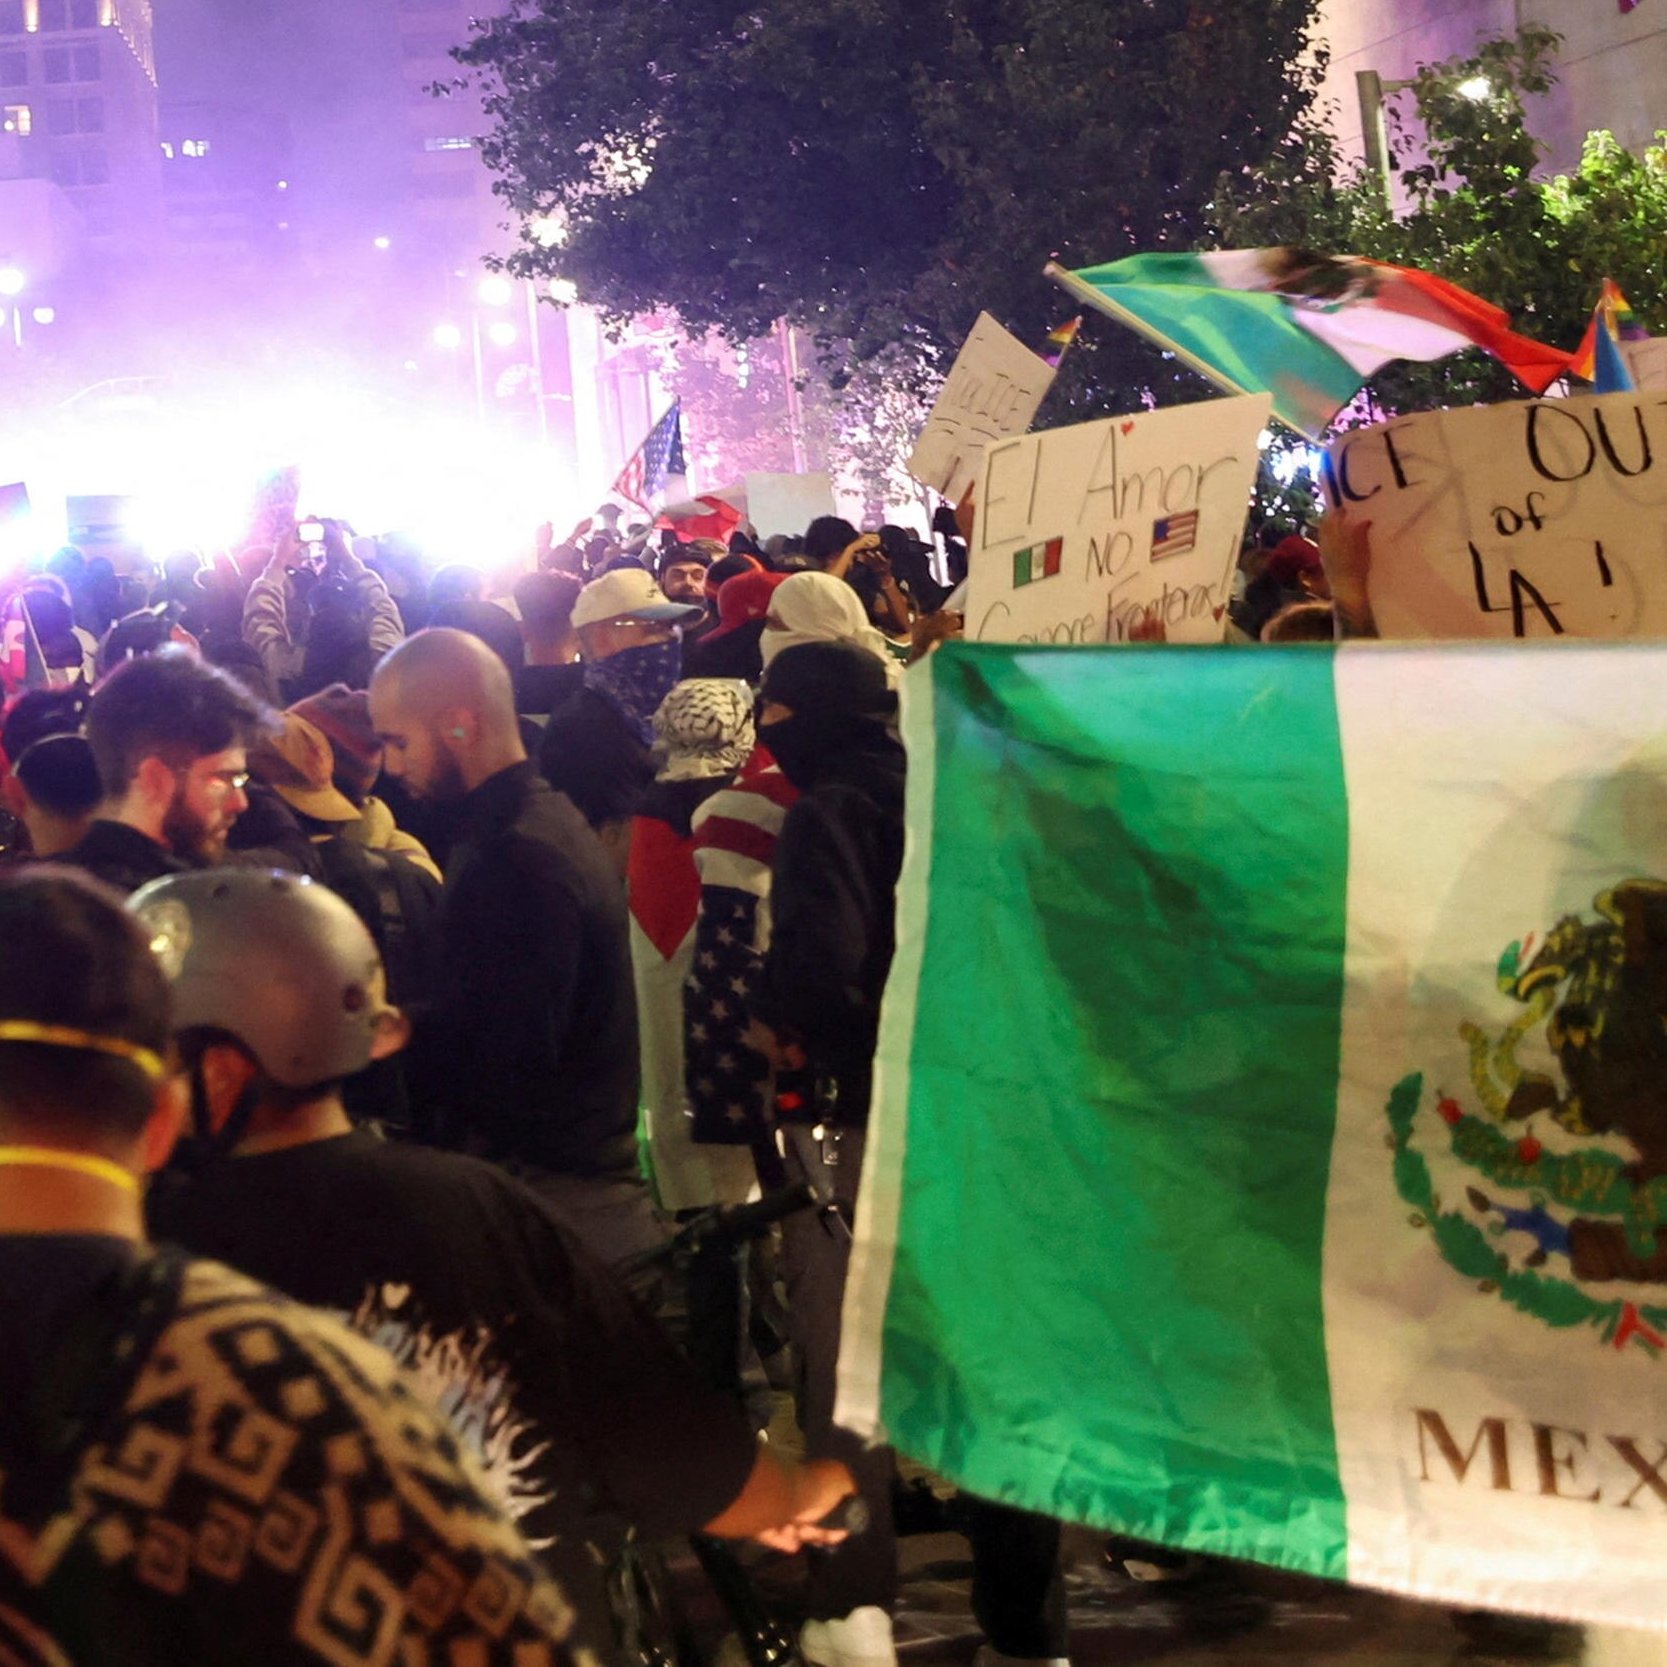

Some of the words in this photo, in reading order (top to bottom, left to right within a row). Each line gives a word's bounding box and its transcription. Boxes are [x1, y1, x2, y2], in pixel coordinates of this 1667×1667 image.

[1525, 401, 1667, 482] OU
[982, 438, 1042, 551] El
[1077, 424, 1239, 526] Amor
[1489, 490, 1550, 537] of
[1085, 532, 1134, 583] NO
